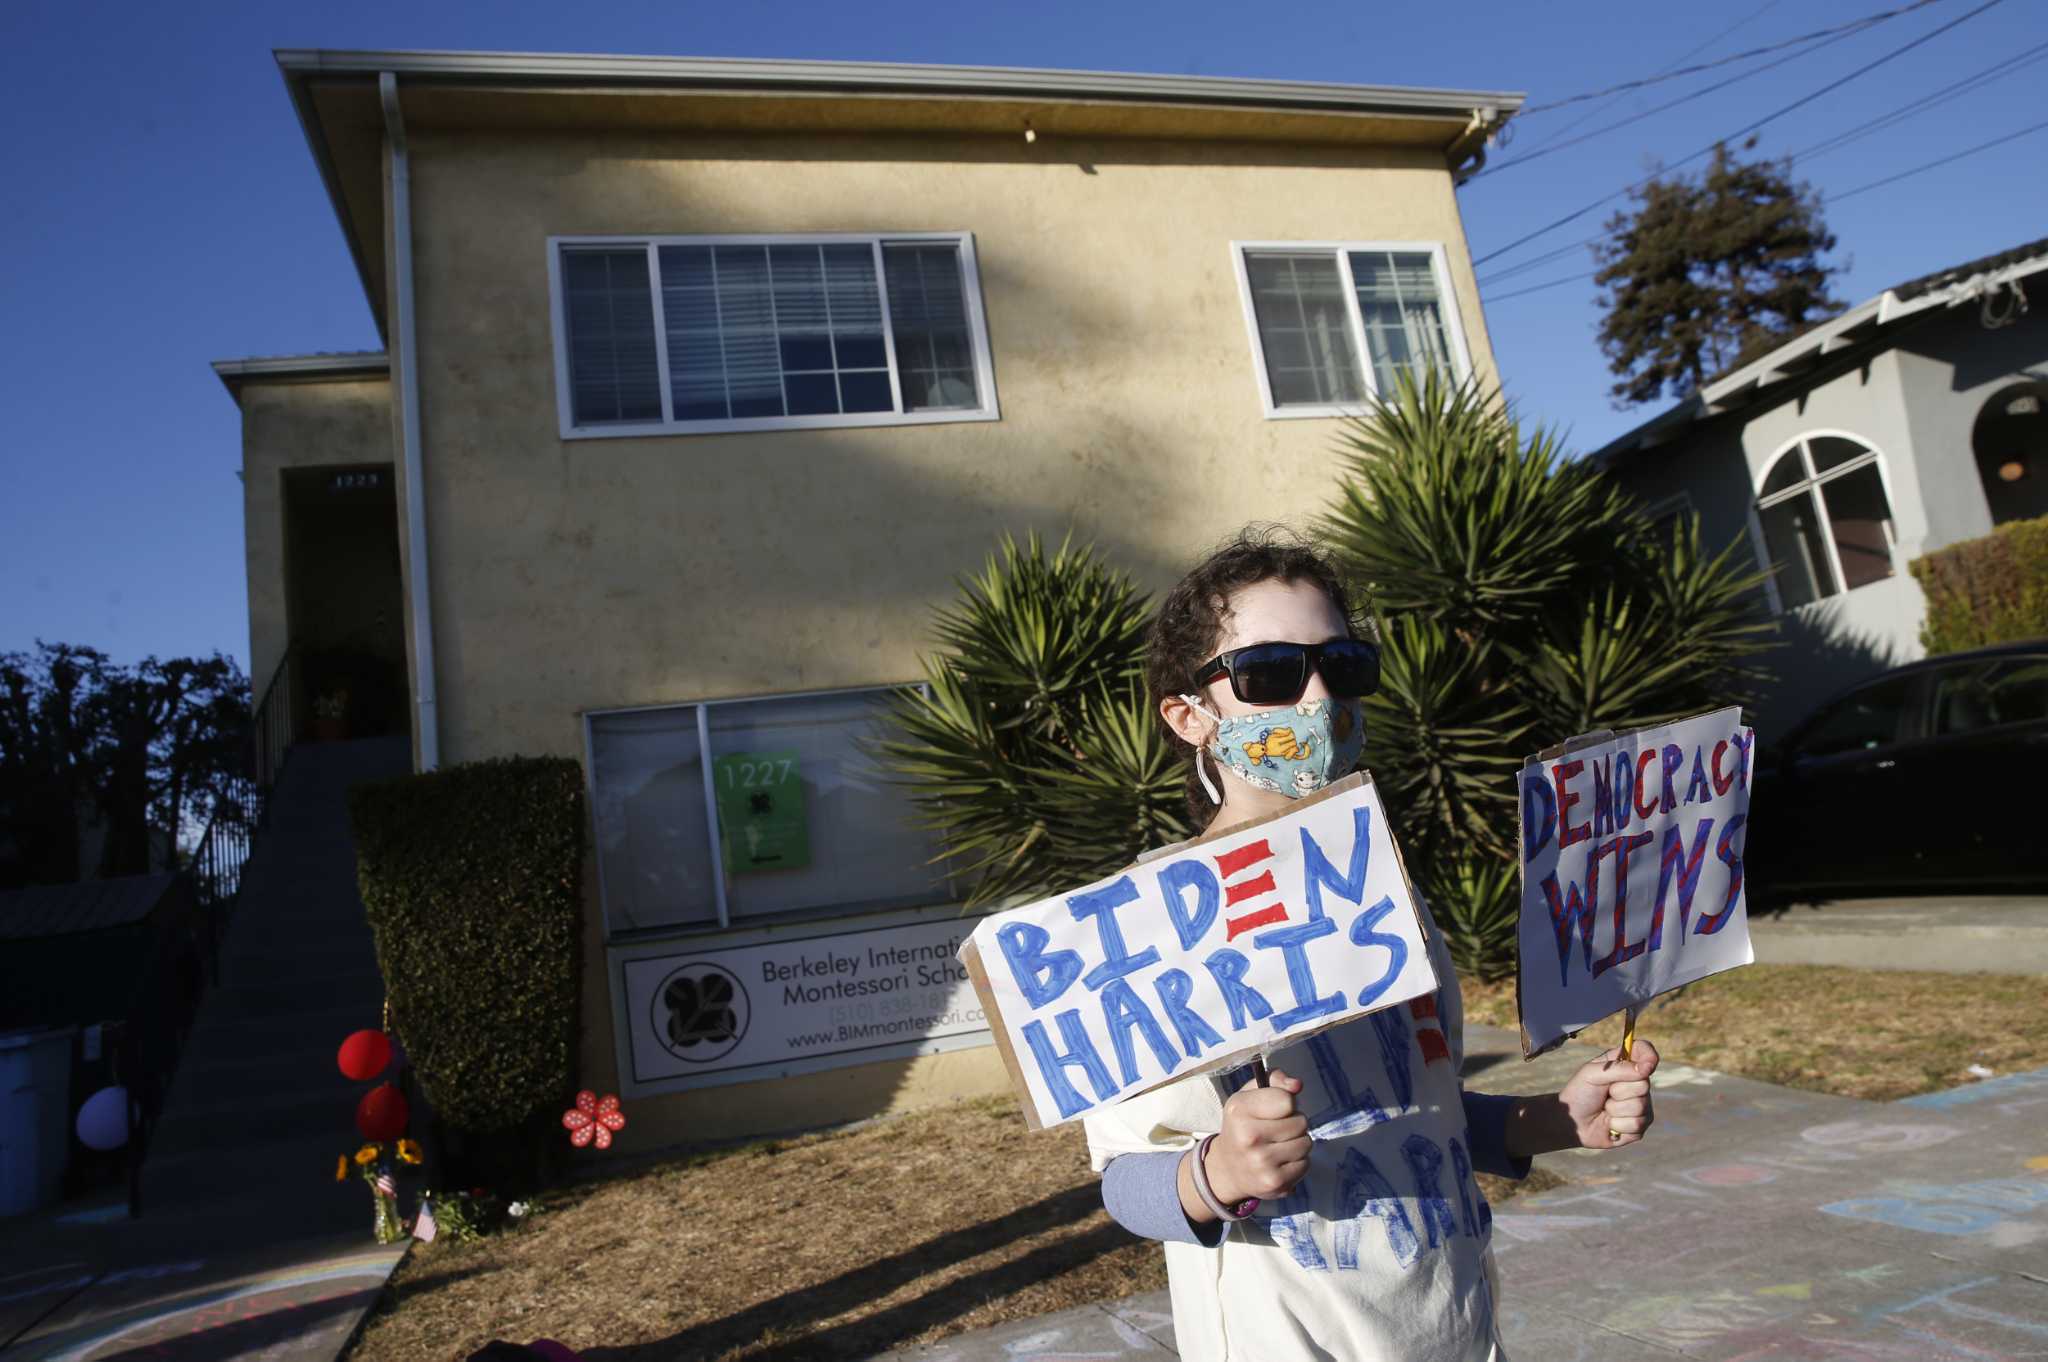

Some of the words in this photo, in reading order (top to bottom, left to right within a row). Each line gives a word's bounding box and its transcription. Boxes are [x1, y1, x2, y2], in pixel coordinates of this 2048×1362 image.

[723, 759, 793, 790] 1227
[1523, 728, 1754, 865] DEMOCRACY
[997, 806, 1370, 1010] BIDEN
[1540, 813, 1746, 987] WINS
[762, 952, 861, 983] Berkeley
[868, 936, 960, 969] Internati
[783, 968, 909, 1006] Montessori
[917, 961, 969, 987] Scho
[786, 1008, 986, 1049] www.BIMmontessori.co
[1021, 894, 1408, 1120] HARRIS
